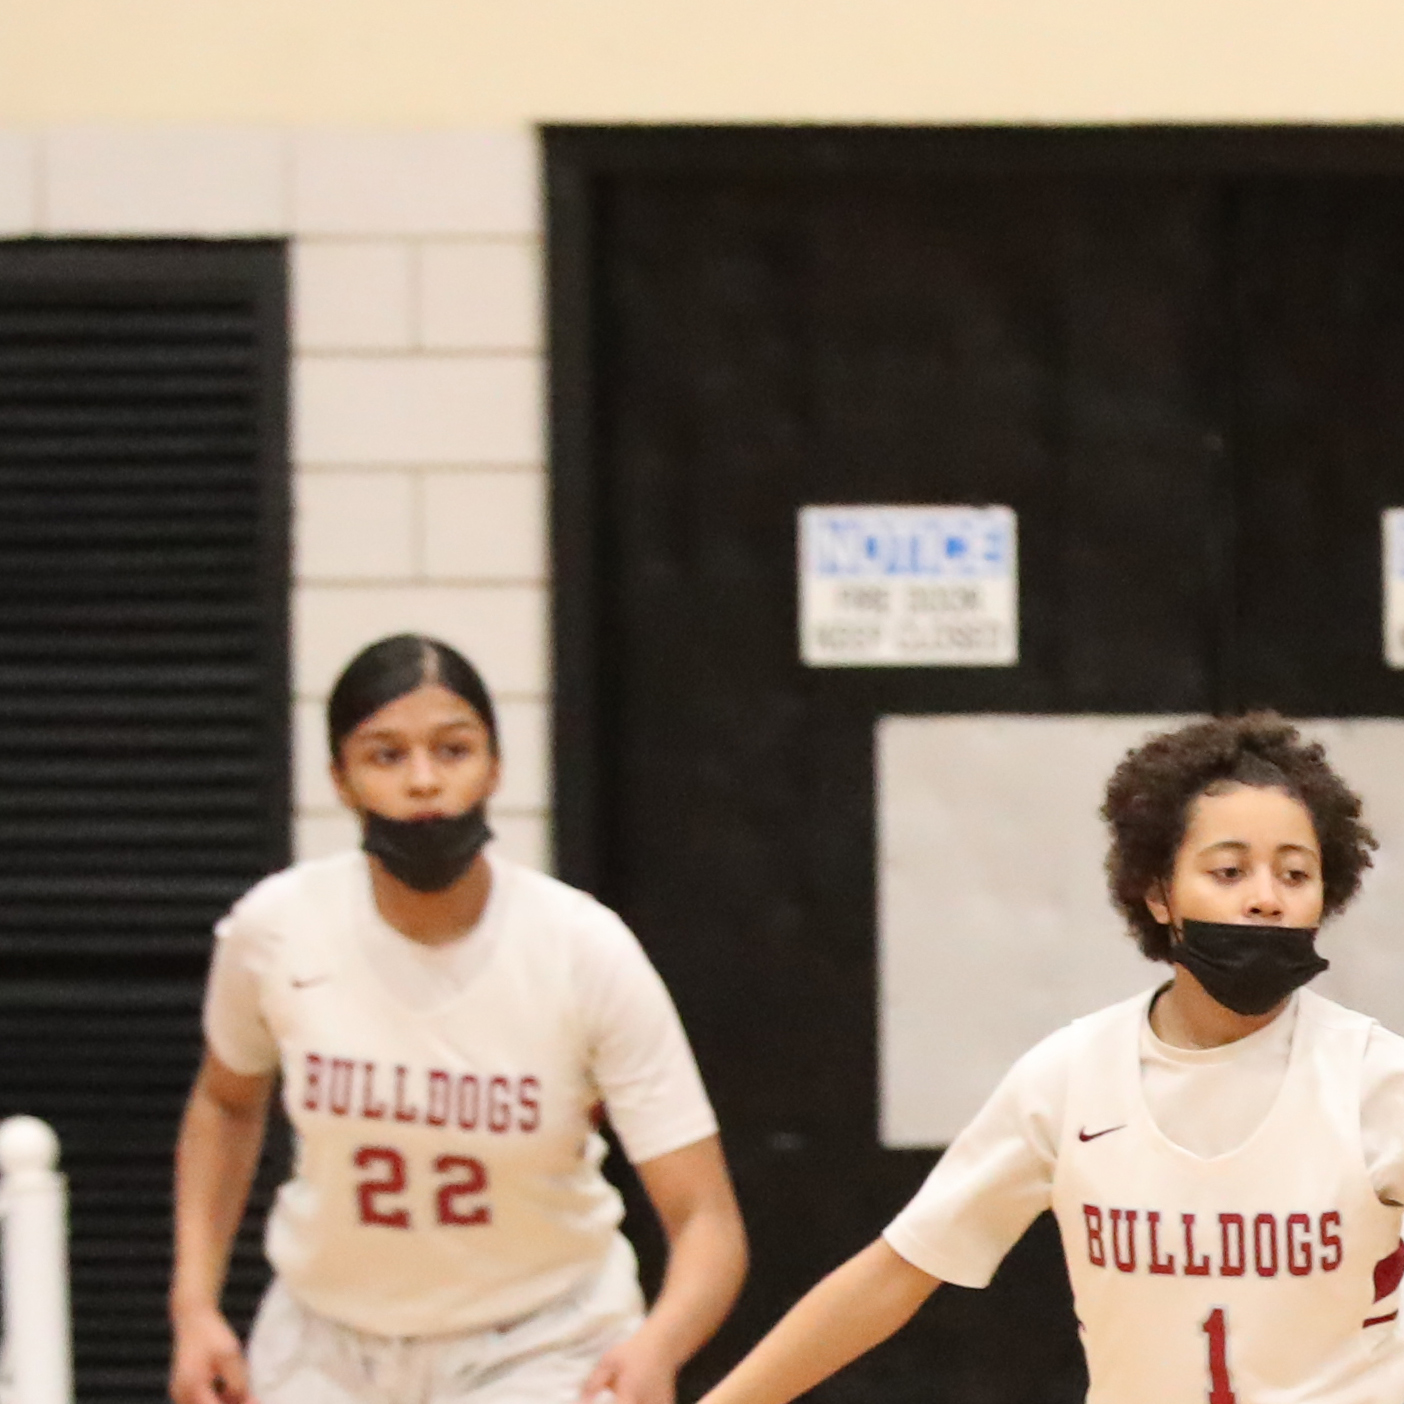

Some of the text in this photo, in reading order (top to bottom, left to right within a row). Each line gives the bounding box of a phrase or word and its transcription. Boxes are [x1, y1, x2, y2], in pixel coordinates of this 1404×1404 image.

[812, 516, 1008, 577] NOTICE
[302, 1052, 542, 1134] BULLDOGS
[353, 1146, 493, 1230] 22
[1082, 1203, 1344, 1278] BULLDOGS
